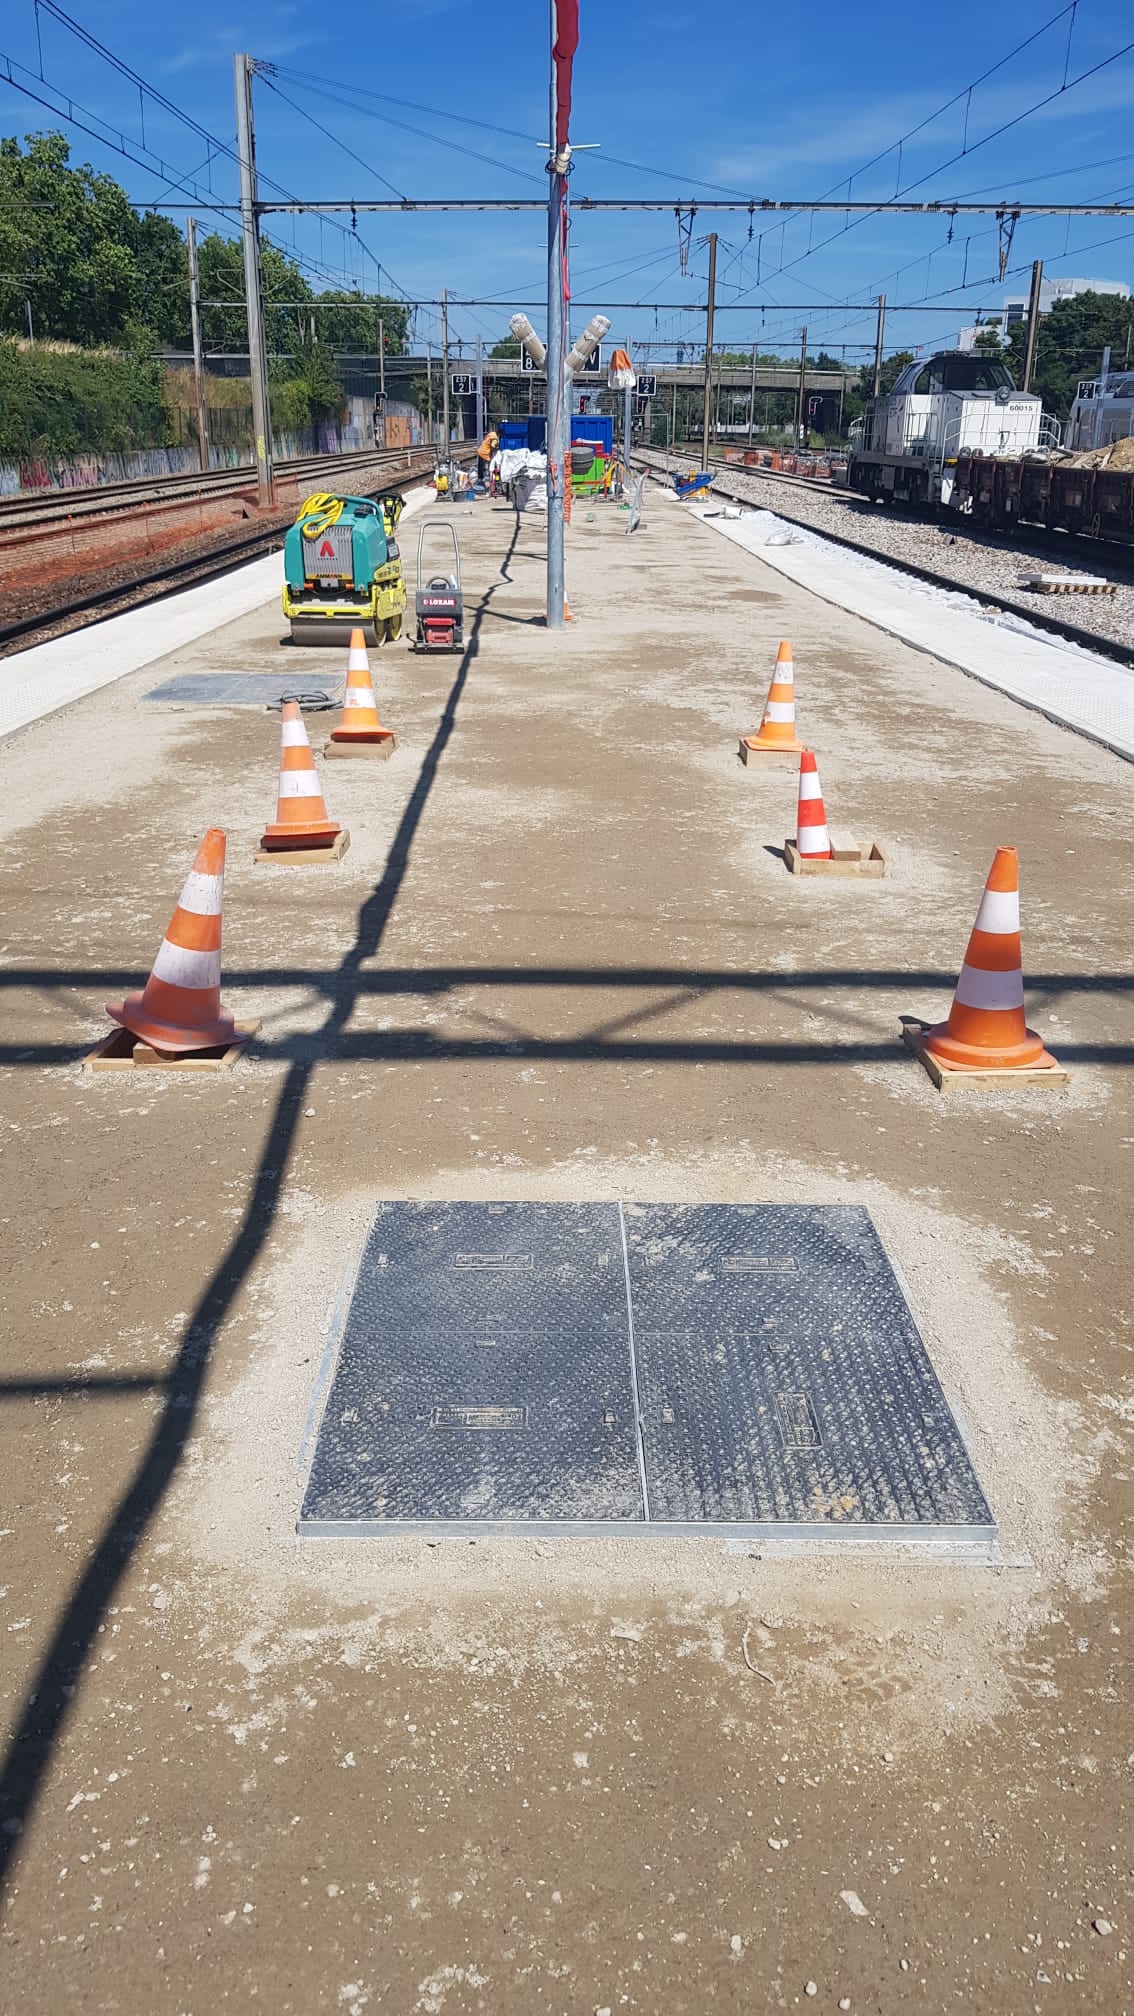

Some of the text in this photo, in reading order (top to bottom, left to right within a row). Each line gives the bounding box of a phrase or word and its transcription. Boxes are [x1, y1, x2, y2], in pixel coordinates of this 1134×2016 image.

[458, 382, 464, 392] 2
[644, 384, 650, 393] 2
[1083, 390, 1088, 398] 2
